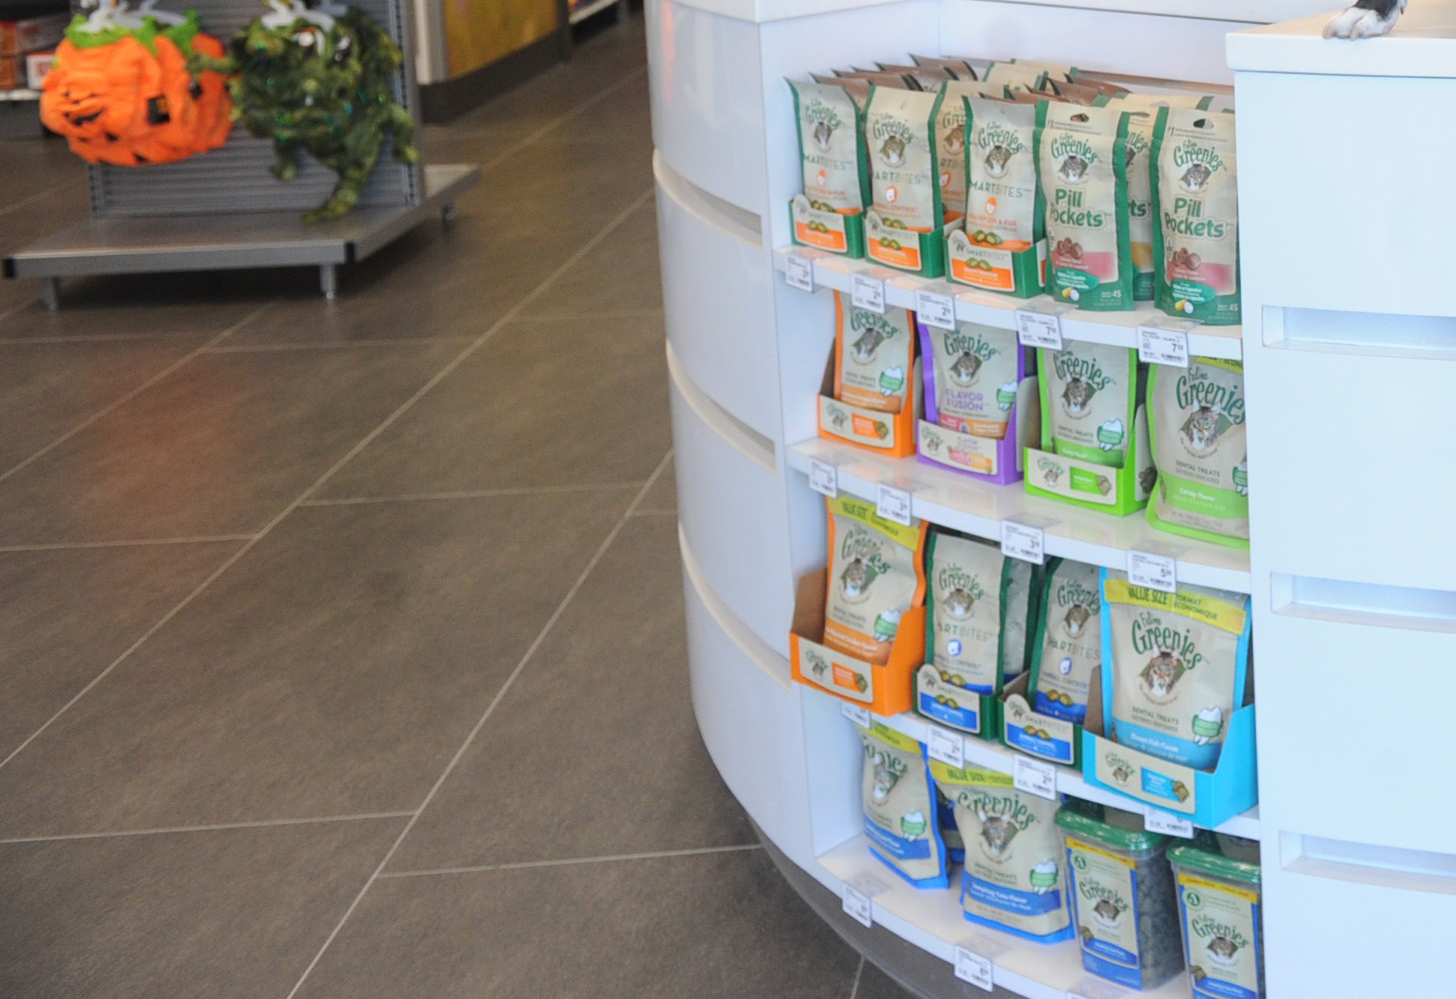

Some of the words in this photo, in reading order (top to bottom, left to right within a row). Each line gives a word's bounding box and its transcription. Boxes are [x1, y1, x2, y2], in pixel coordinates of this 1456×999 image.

[978, 126, 1023, 155] Greenies
[1051, 137, 1097, 164] Greenies
[1174, 146, 1223, 172] Greenies
[971, 181, 1023, 198] MARTBITES
[1055, 188, 1083, 208] Pill
[1174, 197, 1202, 217] Pill
[1164, 212, 1224, 238] Pockets
[944, 331, 996, 361] Greenies
[1054, 353, 1110, 392] Greenies
[945, 389, 983, 401] FLAVOR
[946, 400, 984, 412] FUSION
[939, 569, 984, 600] Greenies
[1132, 618, 1201, 670] Greenies
[957, 791, 1034, 830] Greenies
[1078, 880, 1129, 913] Greenies
[1191, 918, 1249, 949] Greenies
